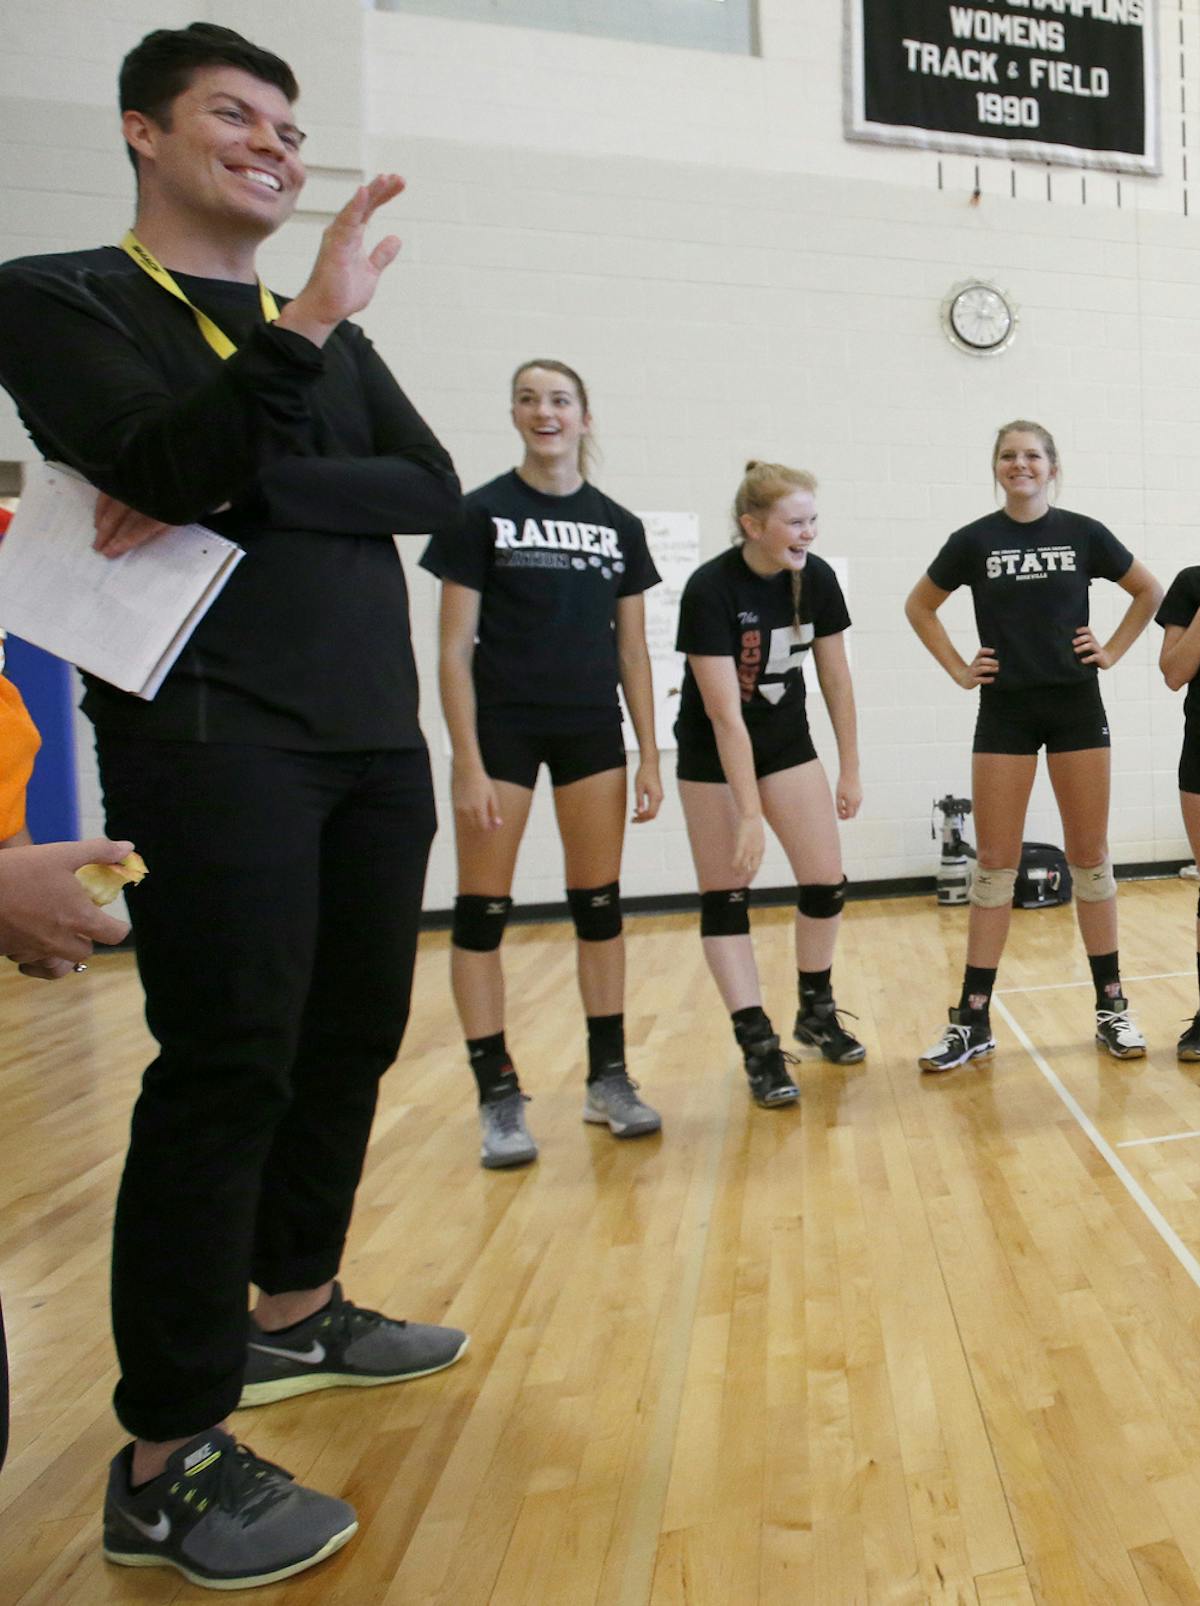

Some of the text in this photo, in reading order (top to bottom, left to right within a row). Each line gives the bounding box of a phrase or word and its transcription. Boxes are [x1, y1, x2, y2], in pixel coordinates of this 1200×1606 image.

[950, 6, 1065, 52] WOMENS
[902, 38, 1110, 98] TRACK & FIELD
[975, 91, 1040, 129] 1990
[491, 516, 624, 559] RAIDER
[986, 551, 1077, 579] STATE
[737, 611, 759, 625] The
